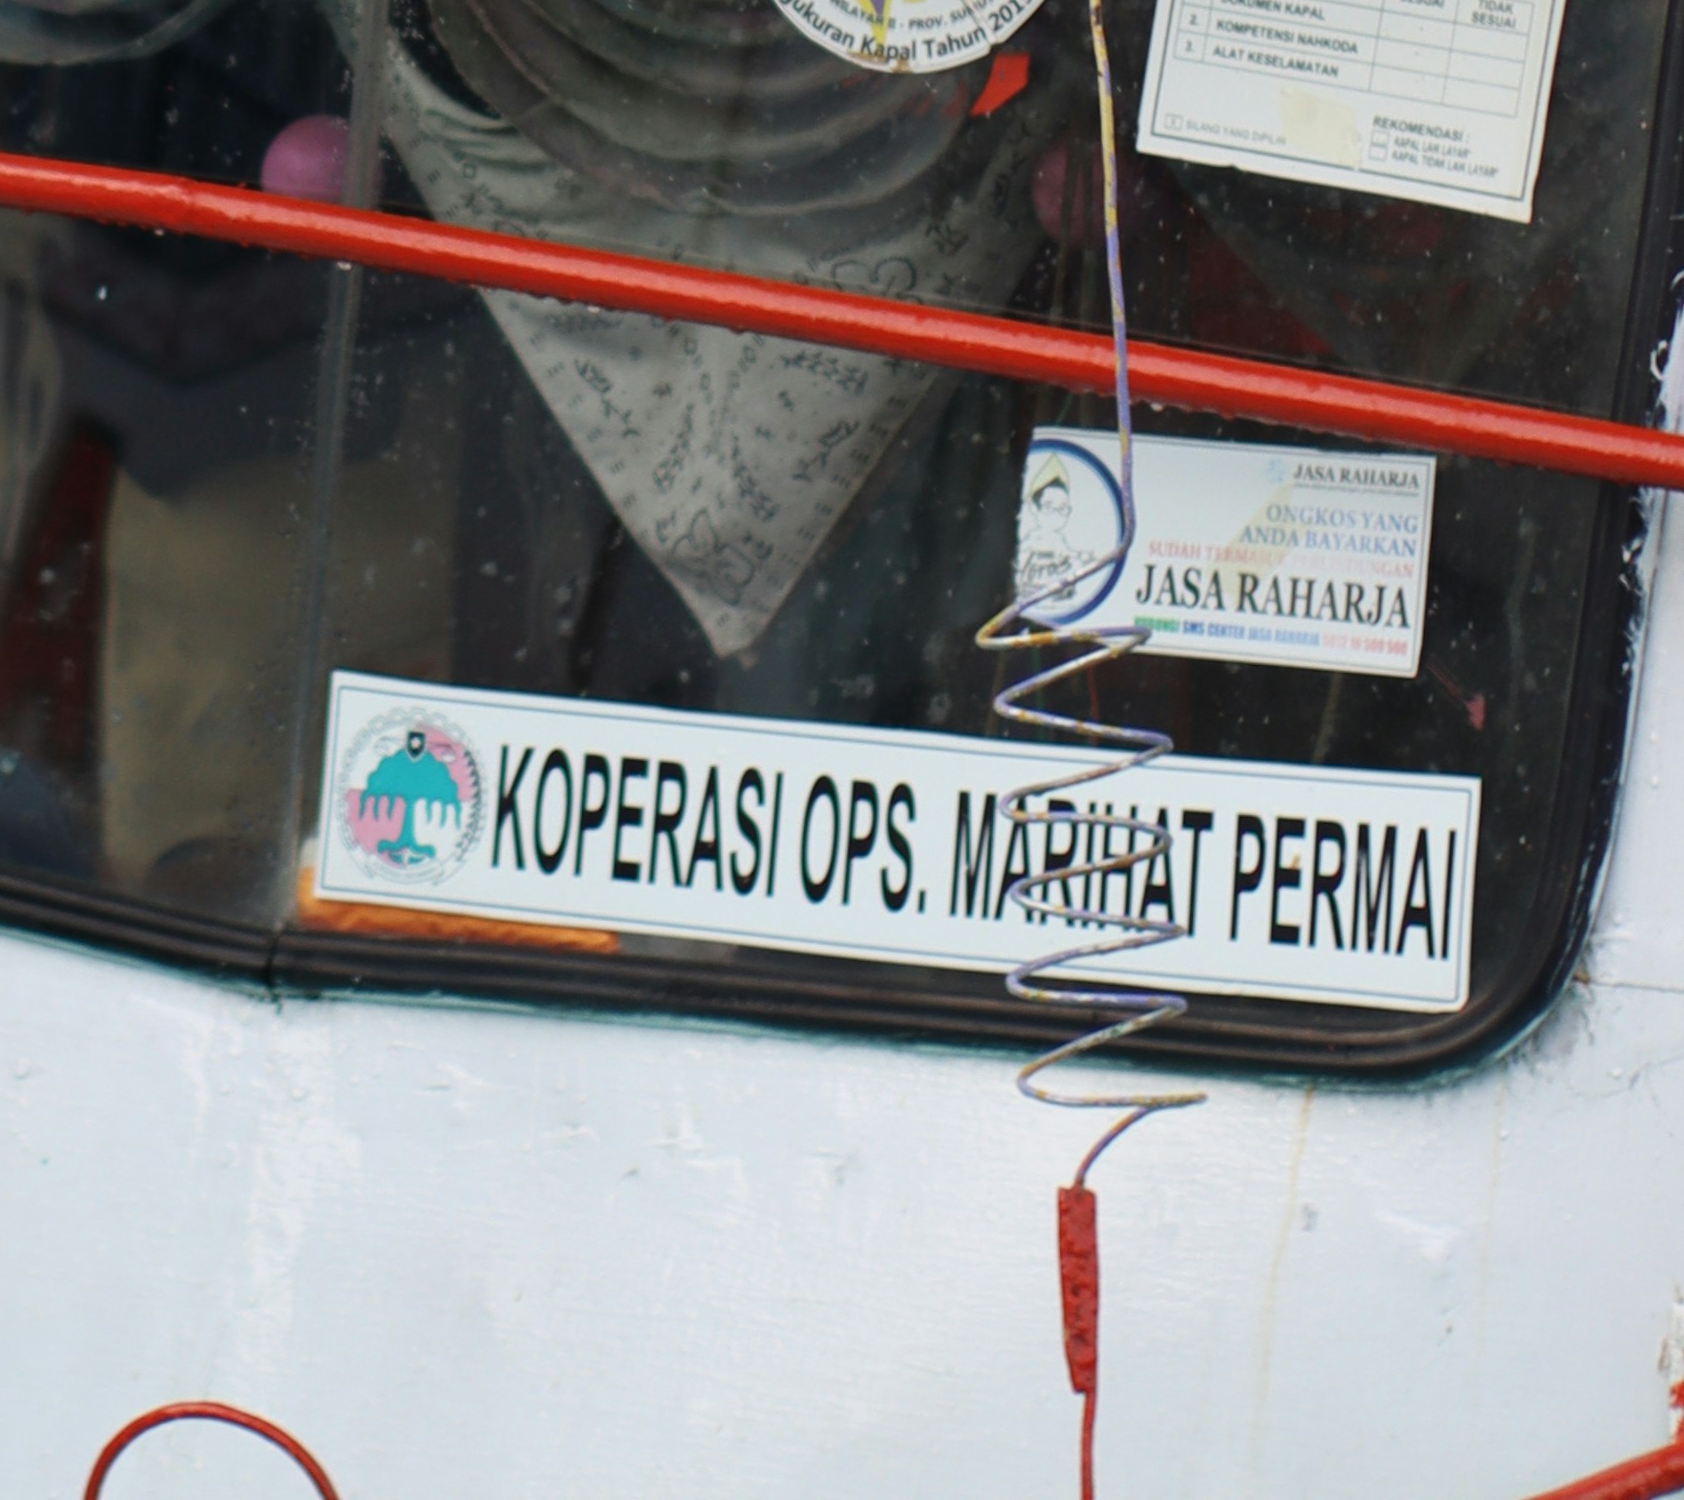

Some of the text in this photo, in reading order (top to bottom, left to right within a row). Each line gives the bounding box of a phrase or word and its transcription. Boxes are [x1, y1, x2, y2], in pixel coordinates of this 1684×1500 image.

[1284, 2, 1326, 21] KAPAL
[861, 34, 916, 61] Kapal
[923, 26, 988, 59] Tahun
[1216, 18, 1295, 42] KOMPETENSI
[1296, 31, 1359, 54] NAHKODA
[1212, 44, 1245, 63] ALAT
[1246, 48, 1340, 78] KESELAMATAN
[1372, 115, 1463, 143] REKOMENDASI
[1293, 463, 1420, 489] JASA RAHARJA
[1266, 502, 1419, 535] ONGKOS YANG
[1238, 524, 1417, 558] ANDA BAYARKAN
[1135, 563, 1227, 612] JASA
[1235, 571, 1411, 629] RAHARJA
[490, 743, 1458, 961] KOPERASI OPS. MARIHAT PERMAI
